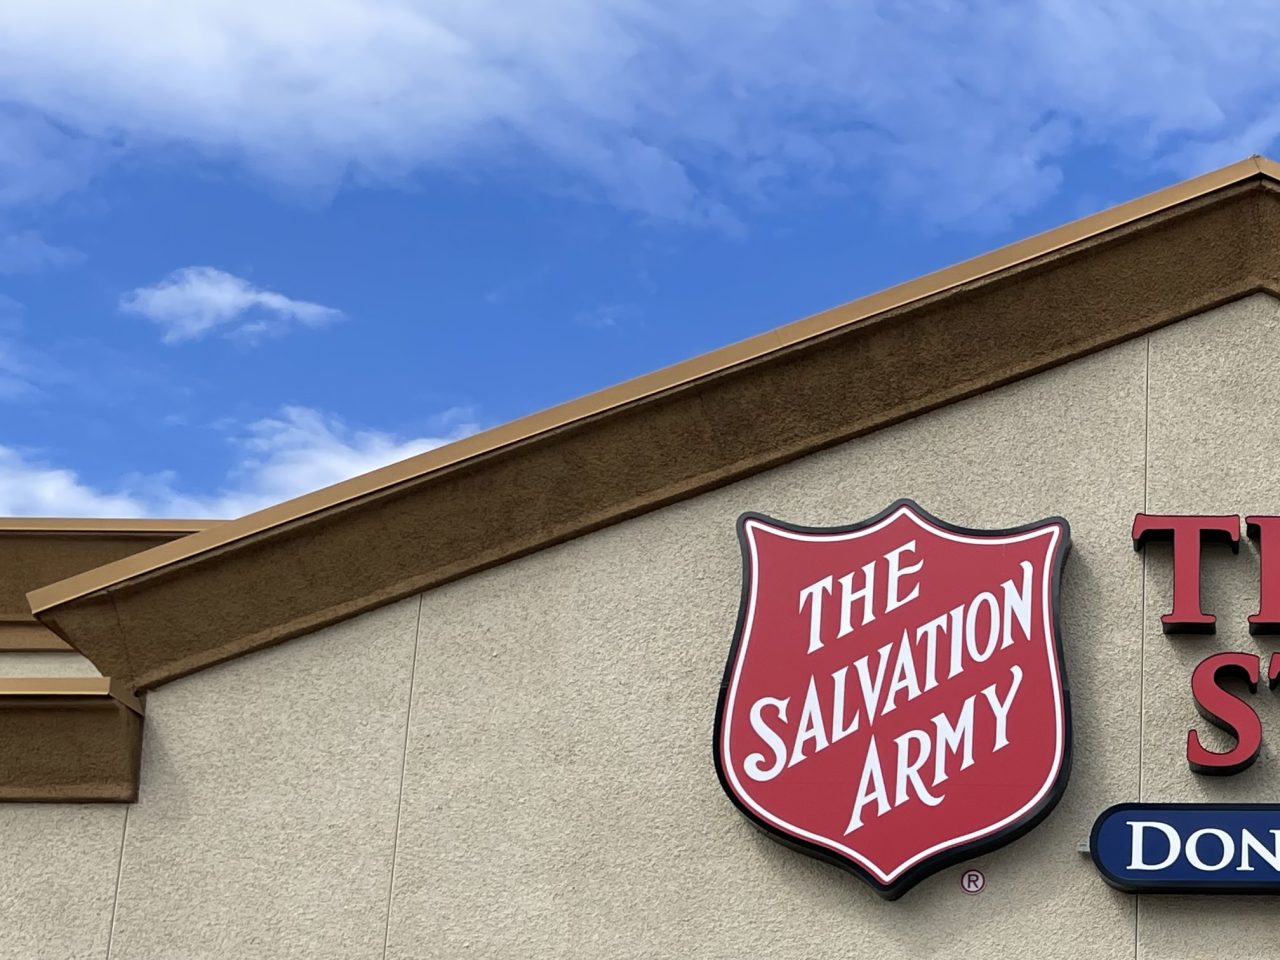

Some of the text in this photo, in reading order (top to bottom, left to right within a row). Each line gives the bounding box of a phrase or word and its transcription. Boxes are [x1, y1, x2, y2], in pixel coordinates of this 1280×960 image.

[743, 560, 1033, 782] SALVATION
[799, 540, 924, 654] THE
[844, 665, 1023, 836] ARMY
